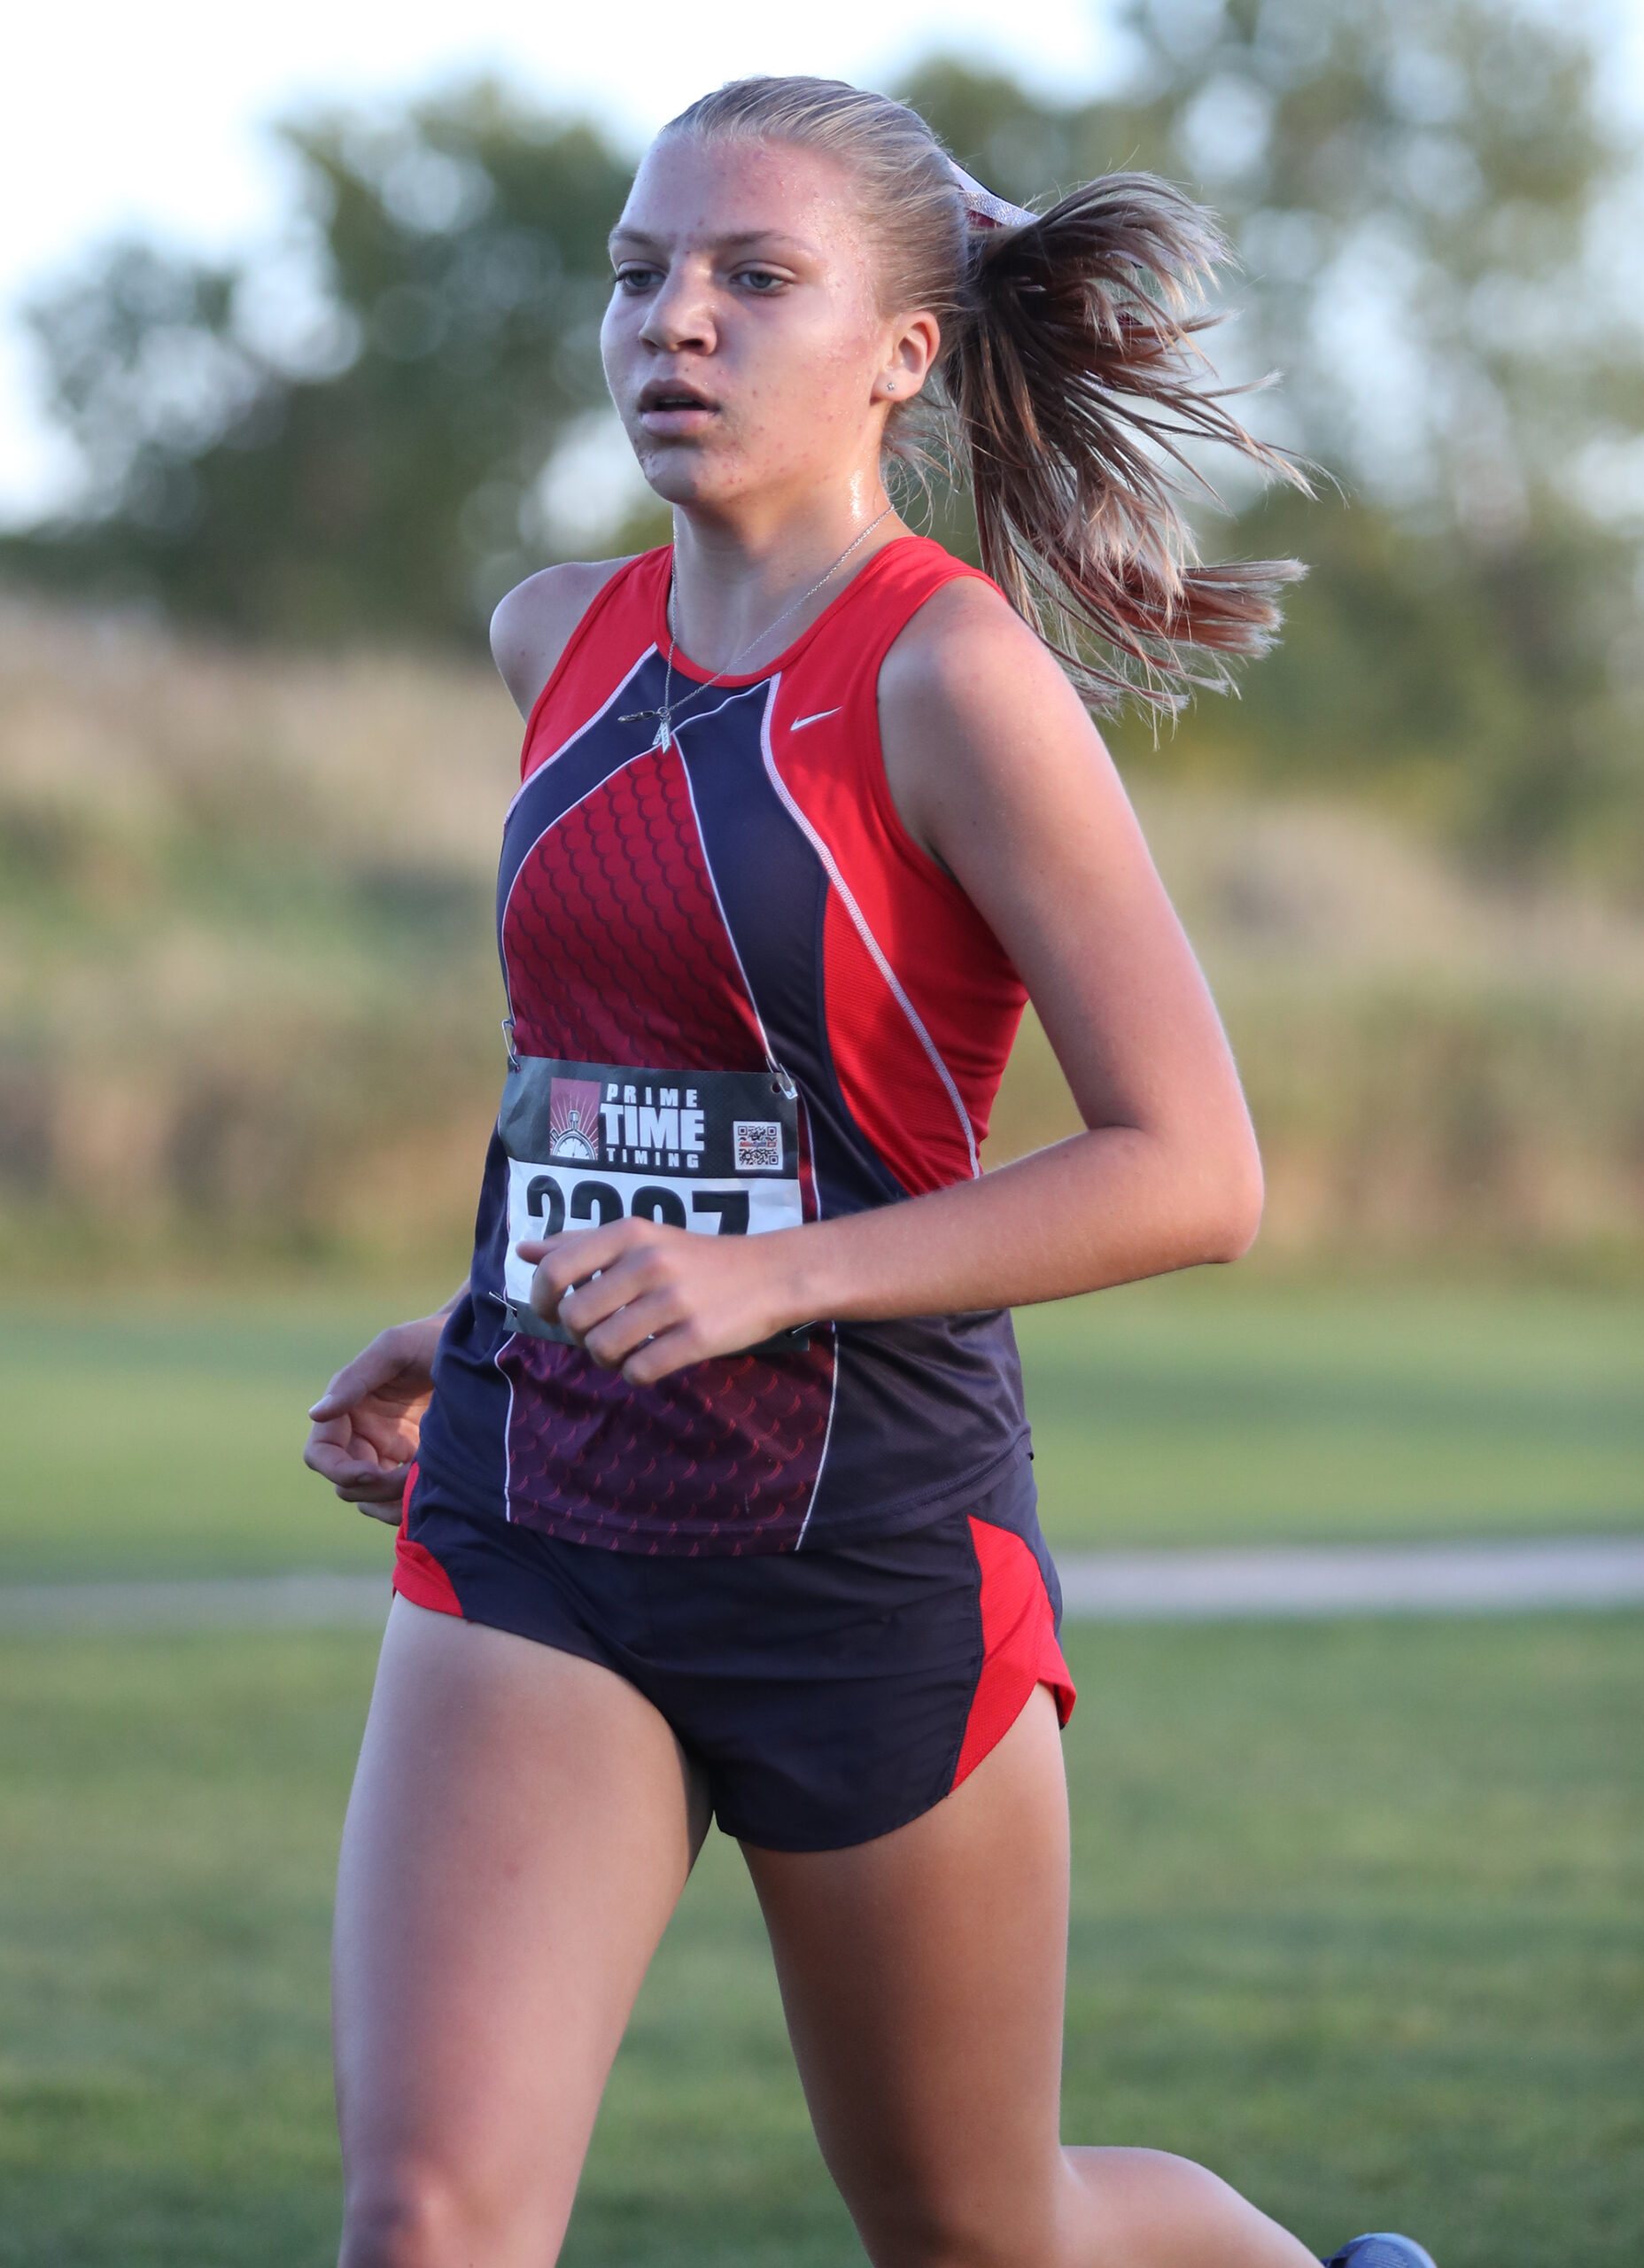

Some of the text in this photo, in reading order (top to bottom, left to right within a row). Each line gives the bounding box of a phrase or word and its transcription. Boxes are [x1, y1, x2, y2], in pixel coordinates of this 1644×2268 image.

[606, 1084, 698, 1107] PRIME
[600, 1103, 705, 1151] TIME
[606, 1147, 700, 1169] TIMING
